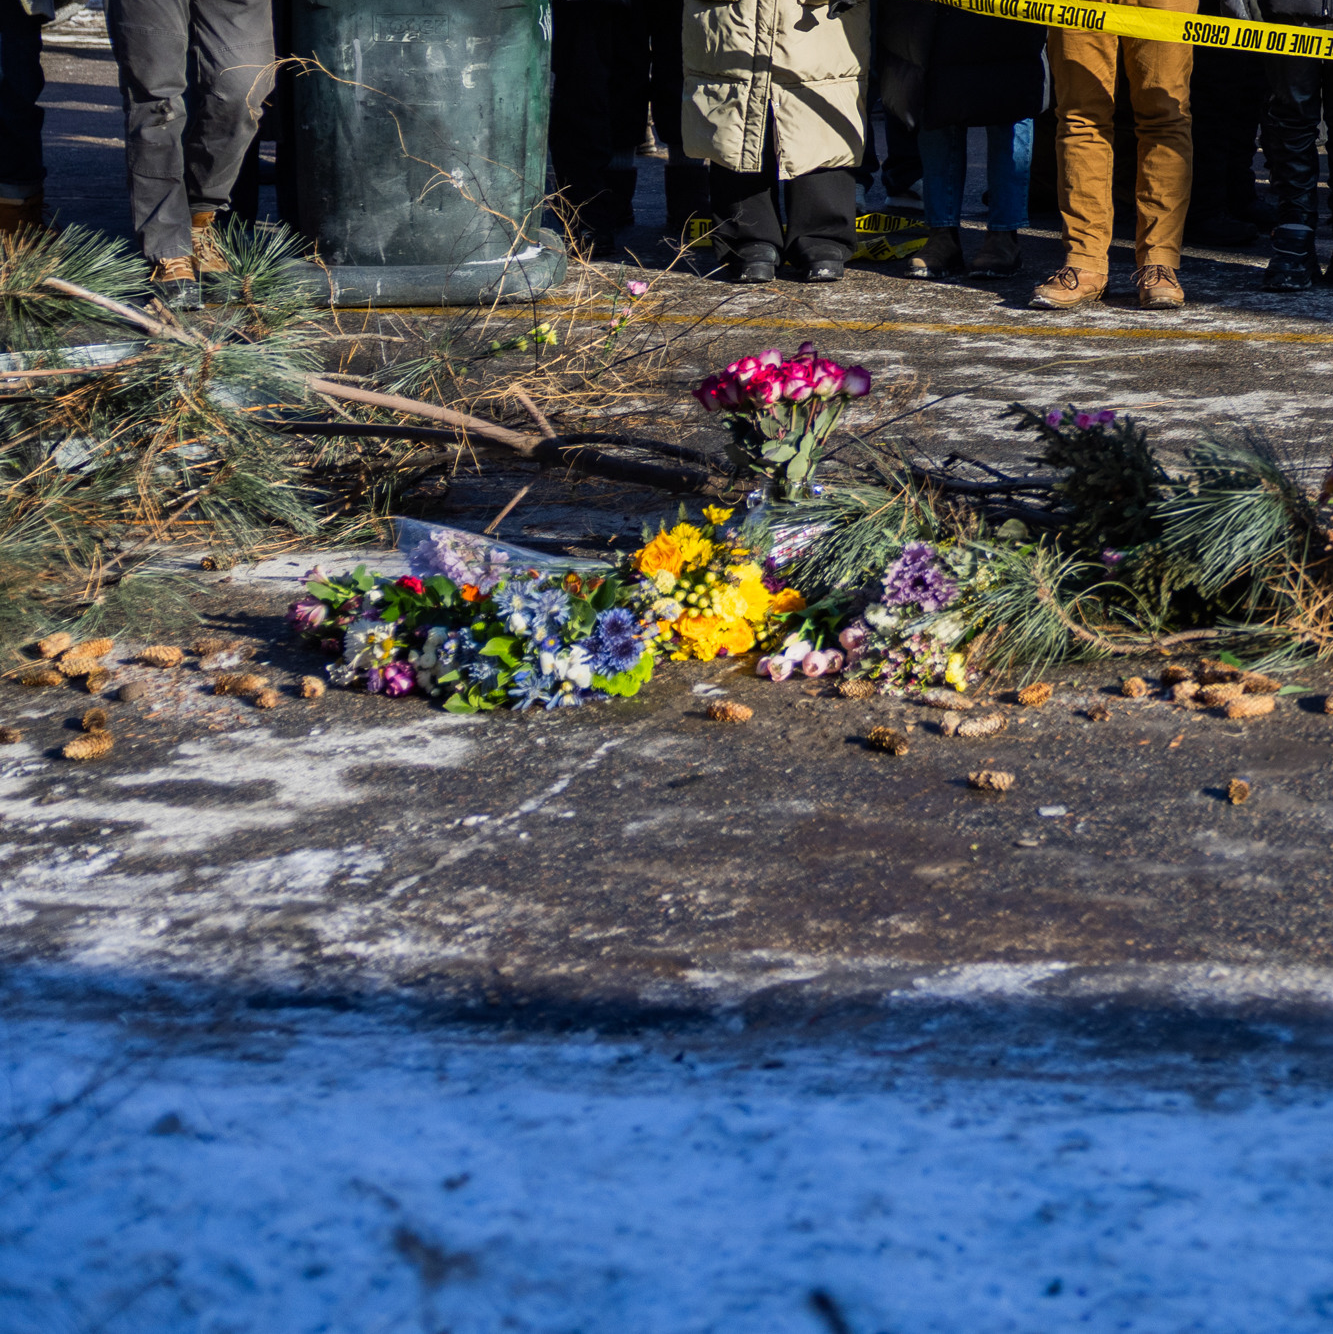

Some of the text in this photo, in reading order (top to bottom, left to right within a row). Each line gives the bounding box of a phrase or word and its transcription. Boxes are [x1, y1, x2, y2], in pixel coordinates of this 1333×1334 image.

[1022, 1, 1054, 24] LINE
[1057, 5, 1106, 30] POLICE
[1182, 21, 1230, 45] CROSS
[1232, 27, 1263, 49] NOT
[1266, 31, 1287, 52] DO
[1289, 33, 1322, 55] LINE
